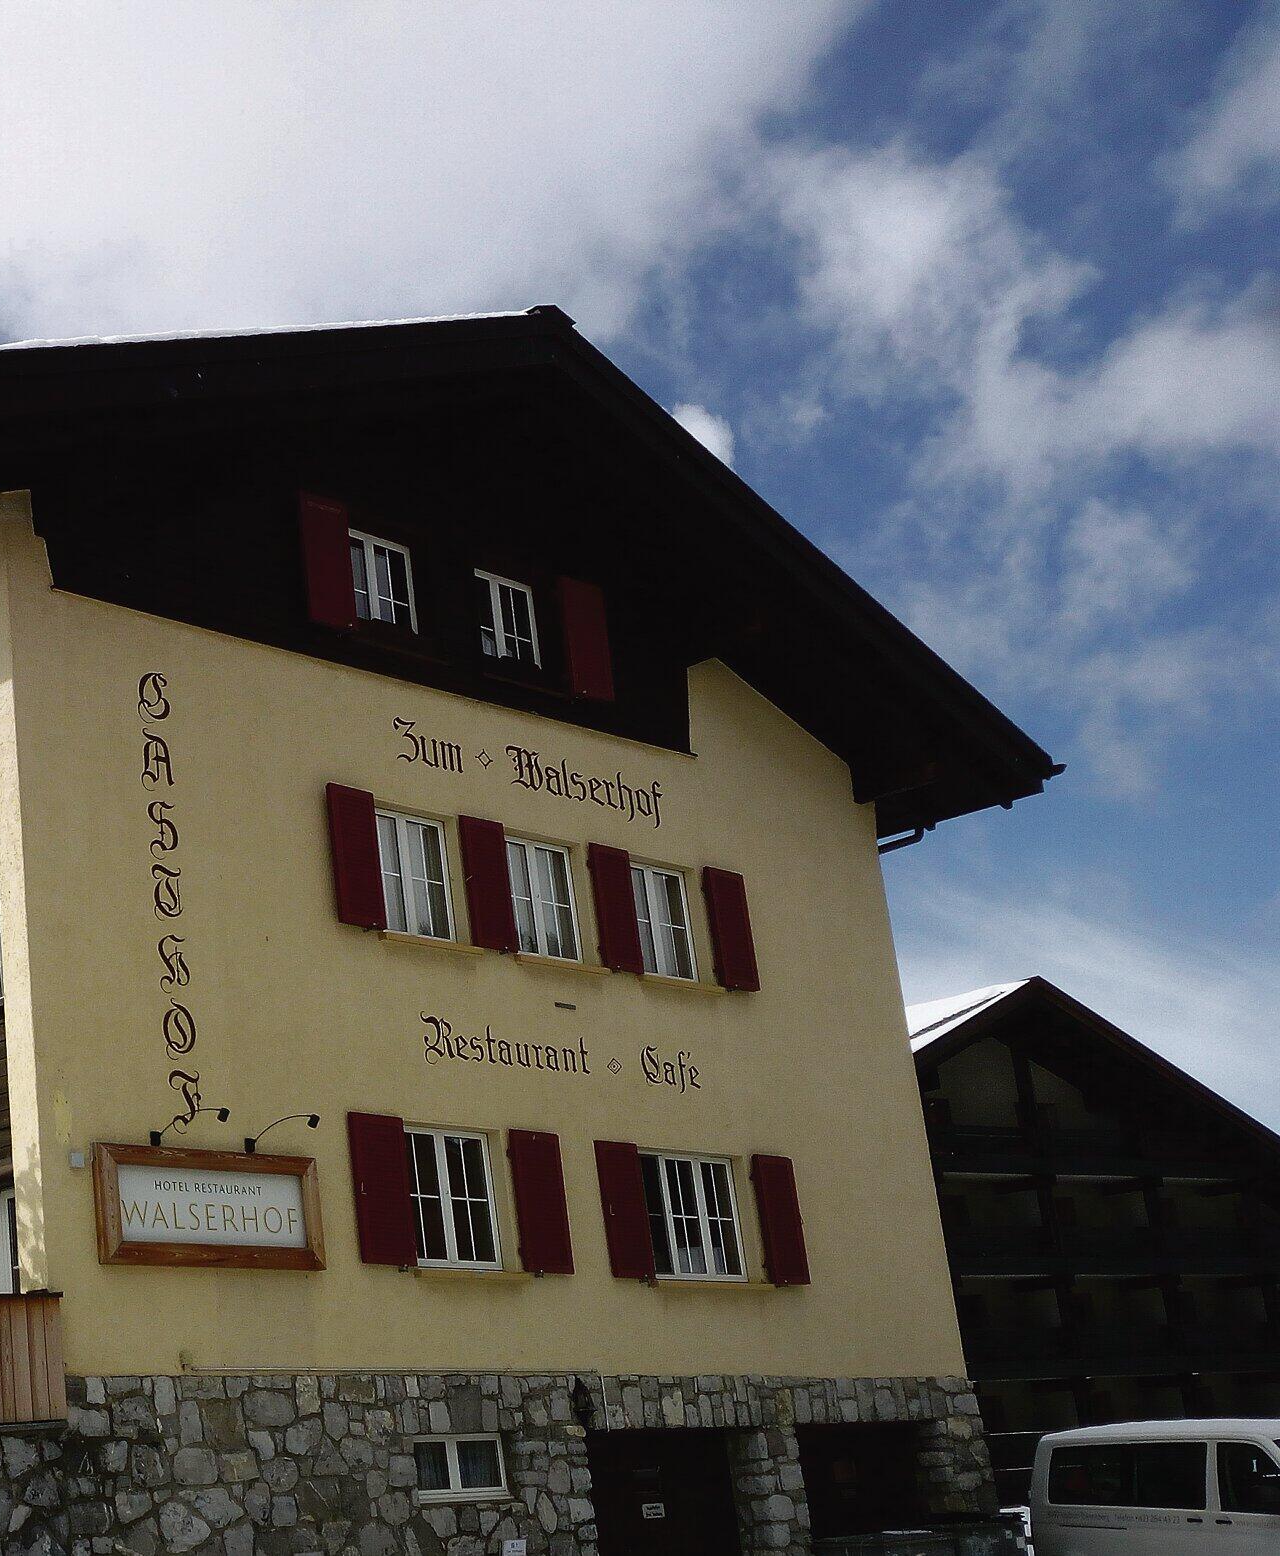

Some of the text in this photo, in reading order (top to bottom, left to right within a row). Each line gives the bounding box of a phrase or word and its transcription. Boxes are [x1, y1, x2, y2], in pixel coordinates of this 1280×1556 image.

[392, 716, 664, 829] Zum Walserhof
[138, 671, 202, 1135] GASTHOF
[419, 1010, 701, 1094] Restaurant Café
[121, 1199, 298, 1234] WALSERHOF
[154, 1179, 262, 1196] HOTEL RESTAURANT
